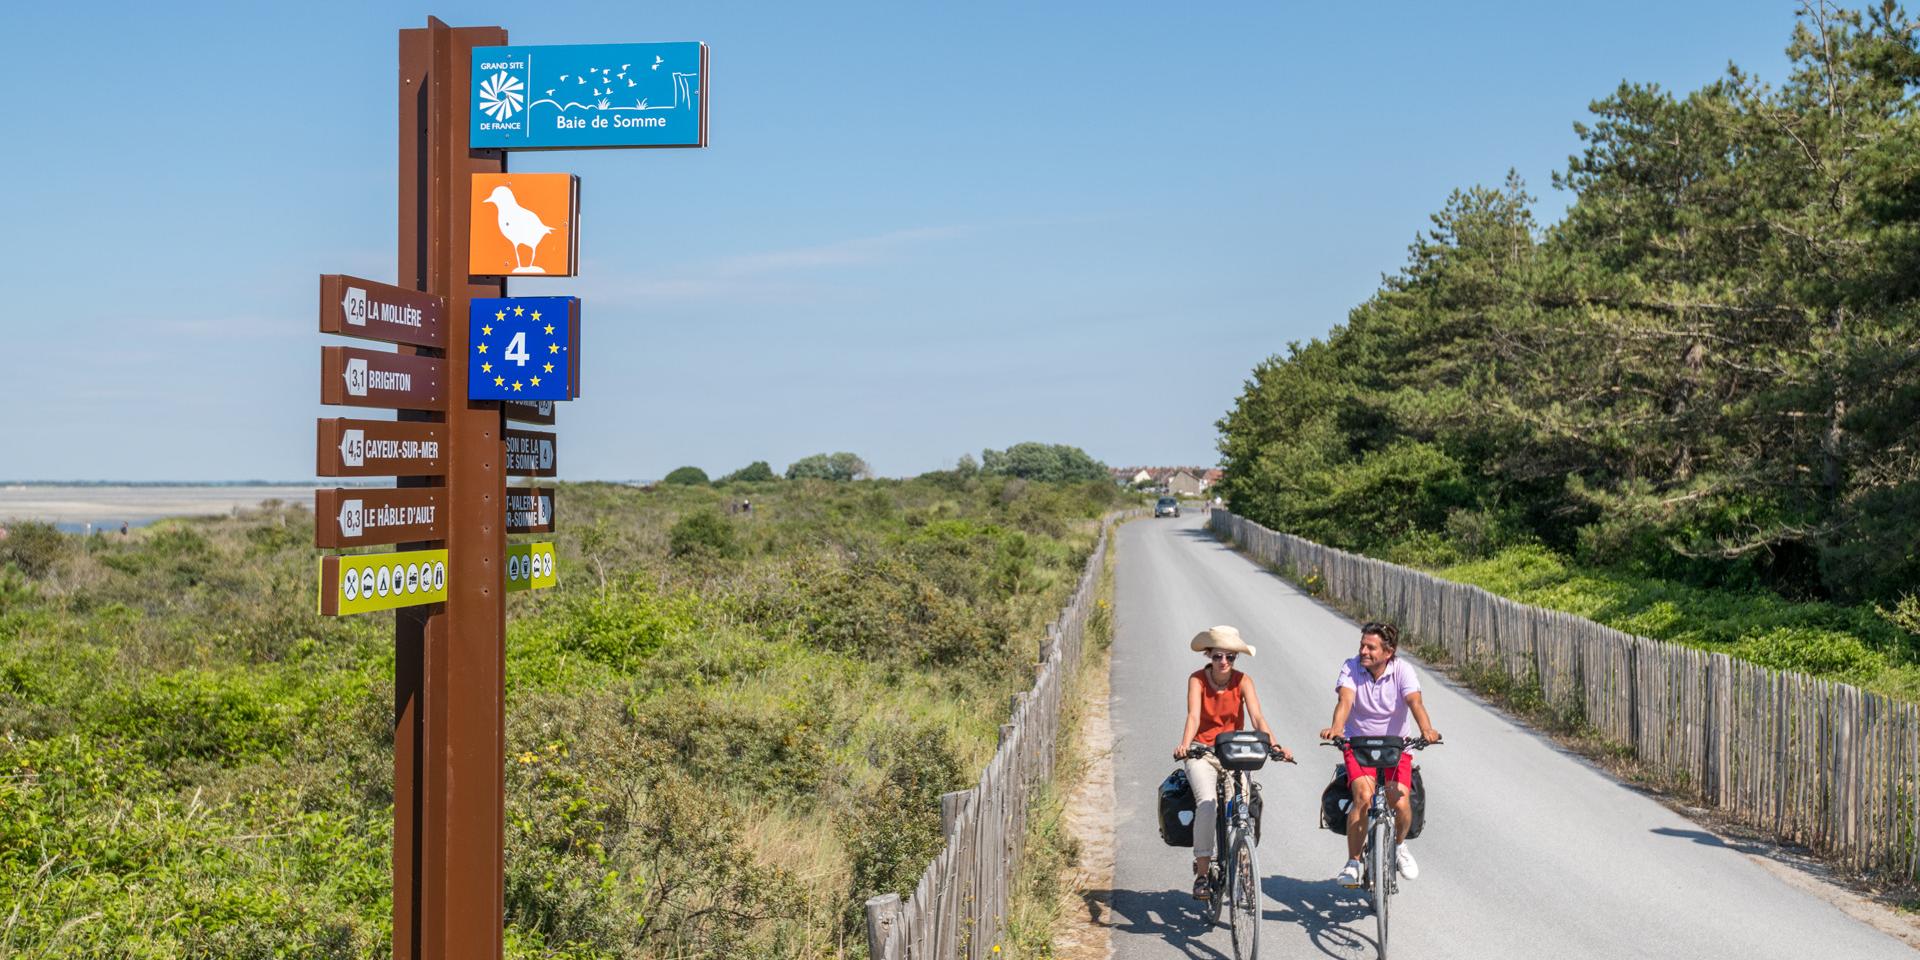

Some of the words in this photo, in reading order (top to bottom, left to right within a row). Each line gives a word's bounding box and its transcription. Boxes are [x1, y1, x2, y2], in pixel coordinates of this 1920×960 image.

[480, 62, 508, 70] GRAND
[509, 61, 524, 69] SITE
[491, 122, 521, 130] FRANCE
[556, 115, 586, 129] Baie
[591, 115, 609, 128] de
[613, 114, 666, 128] Somme
[351, 297, 365, 321] 2,6
[368, 300, 379, 320] LA
[381, 303, 422, 328] MOLLIÈRE
[504, 332, 530, 367] 4
[352, 369, 365, 390] 3,1
[368, 370, 411, 392] BRIGHTON
[348, 440, 362, 461] 4,5
[365, 440, 438, 459] CAYEUX-SUR-MER
[521, 438, 529, 453] DE
[530, 439, 539, 454] LA
[515, 454, 539, 470] SOMME
[346, 510, 361, 531] 8,3
[364, 508, 375, 527] LE
[378, 503, 405, 526] HÂBLE
[407, 506, 435, 525] D'AULT
